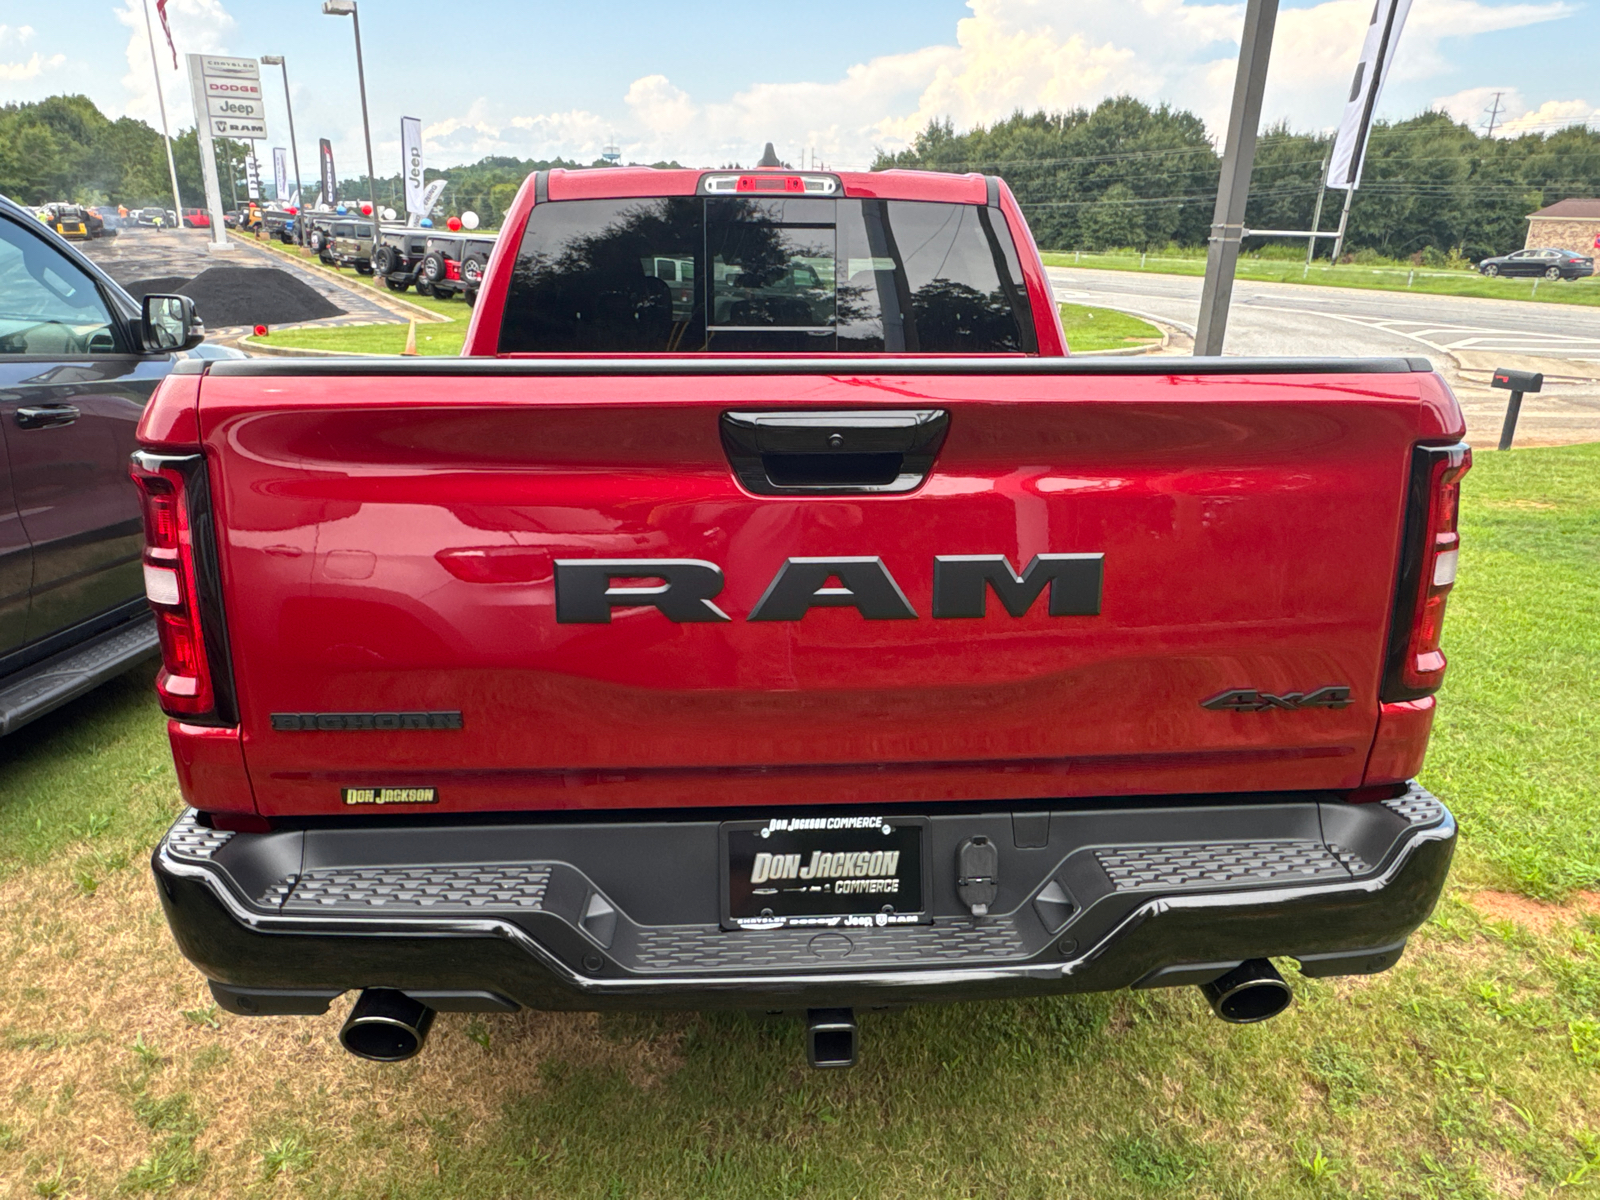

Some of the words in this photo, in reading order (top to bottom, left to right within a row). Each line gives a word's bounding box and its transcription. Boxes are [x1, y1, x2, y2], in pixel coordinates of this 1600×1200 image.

[207, 60, 255, 69] CHRYSLER
[209, 83, 259, 93] DODGE
[220, 100, 254, 116] Jeep
[229, 124, 264, 132] RAM
[408, 146, 421, 189] Jeep
[553, 552, 1106, 623] RAM
[827, 816, 883, 829] COMMERCE
[834, 879, 900, 894] COMMERCE
[737, 917, 787, 925] CHRYSLER
[844, 914, 873, 927] Jeep
